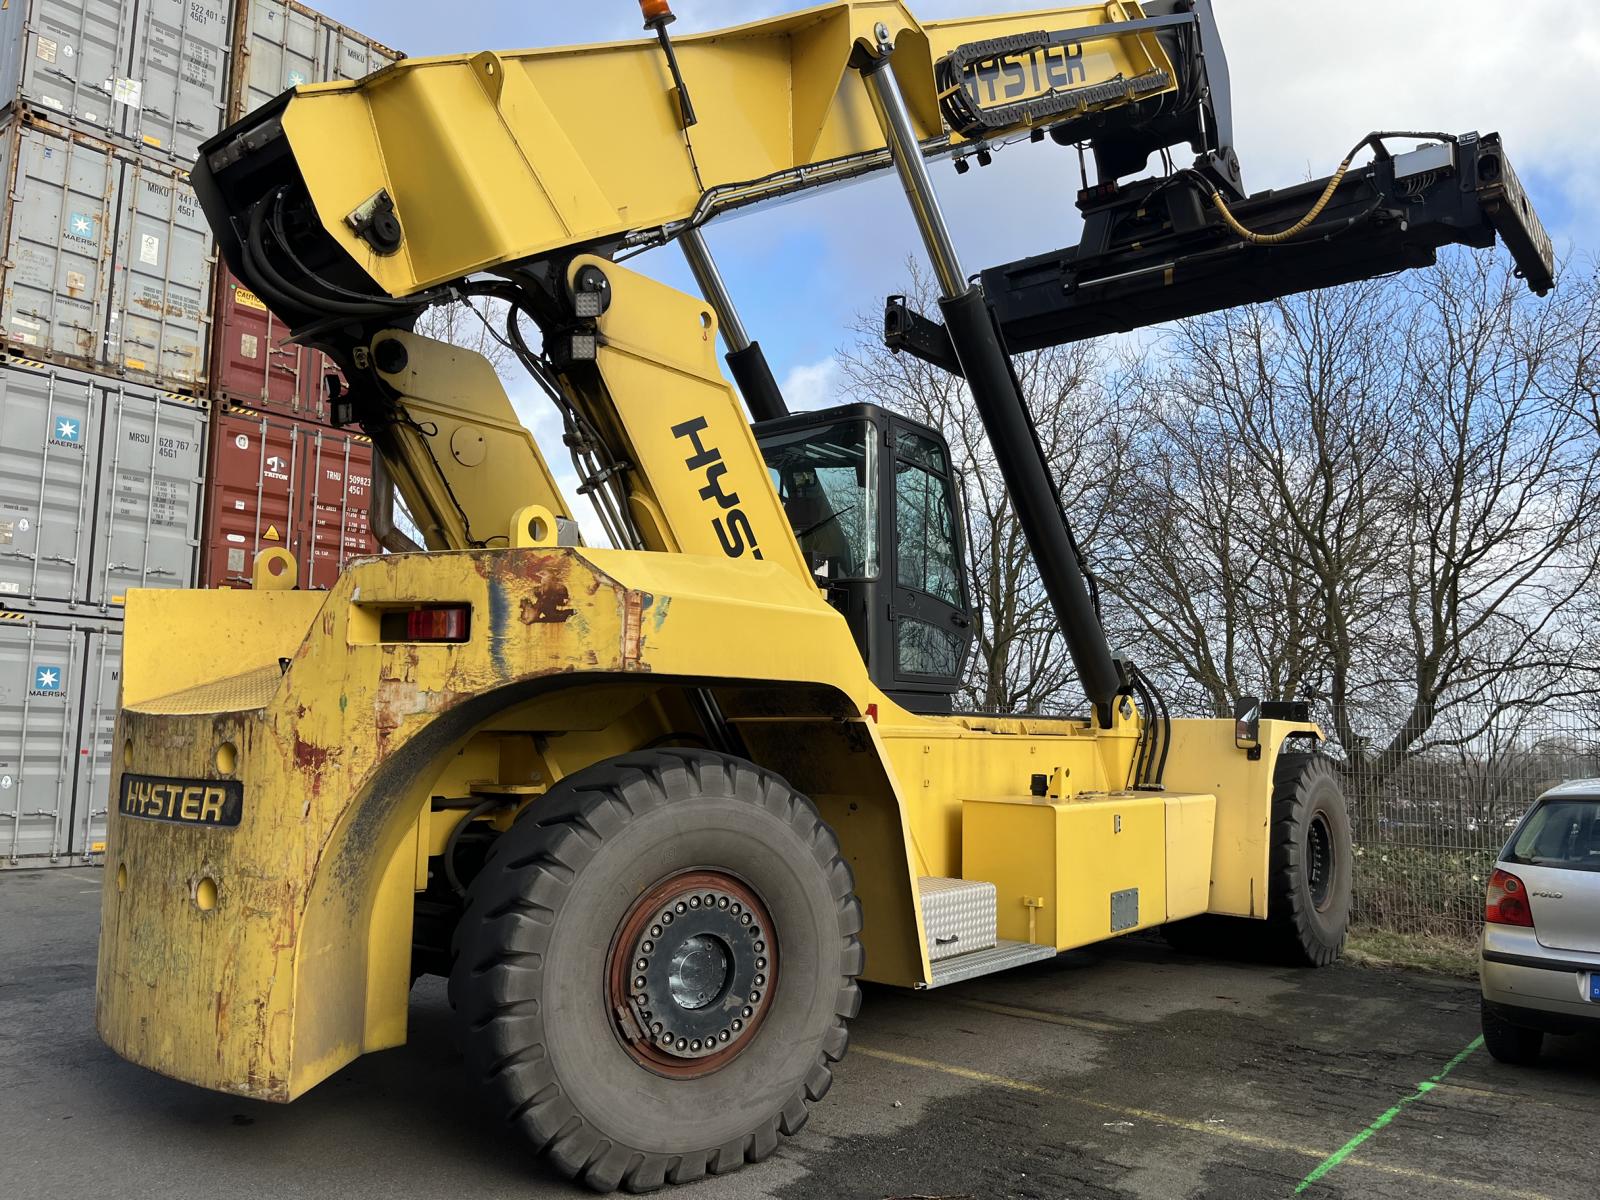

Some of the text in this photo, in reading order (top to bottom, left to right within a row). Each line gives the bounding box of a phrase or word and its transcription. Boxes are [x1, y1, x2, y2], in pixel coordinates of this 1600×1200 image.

[190, 11, 207, 24] 45G1
[191, 2, 204, 14] 522
[205, 9, 218, 20] 401
[347, 49, 365, 63] MRKU
[147, 183, 169, 197] MRKU
[179, 194, 191, 205] 441
[177, 205, 195, 217] 45G1
[63, 233, 98, 248] MAERSK
[48, 439, 84, 450] MAERSK
[129, 431, 199, 453] MRSU 628 767 7
[159, 447, 177, 458] 45G1
[264, 471, 288, 480] TRITON
[326, 470, 371, 487] TRHU 509823
[348, 485, 363, 496] 45G1
[671, 416, 763, 560] HYS
[126, 781, 225, 821] HYSTER
